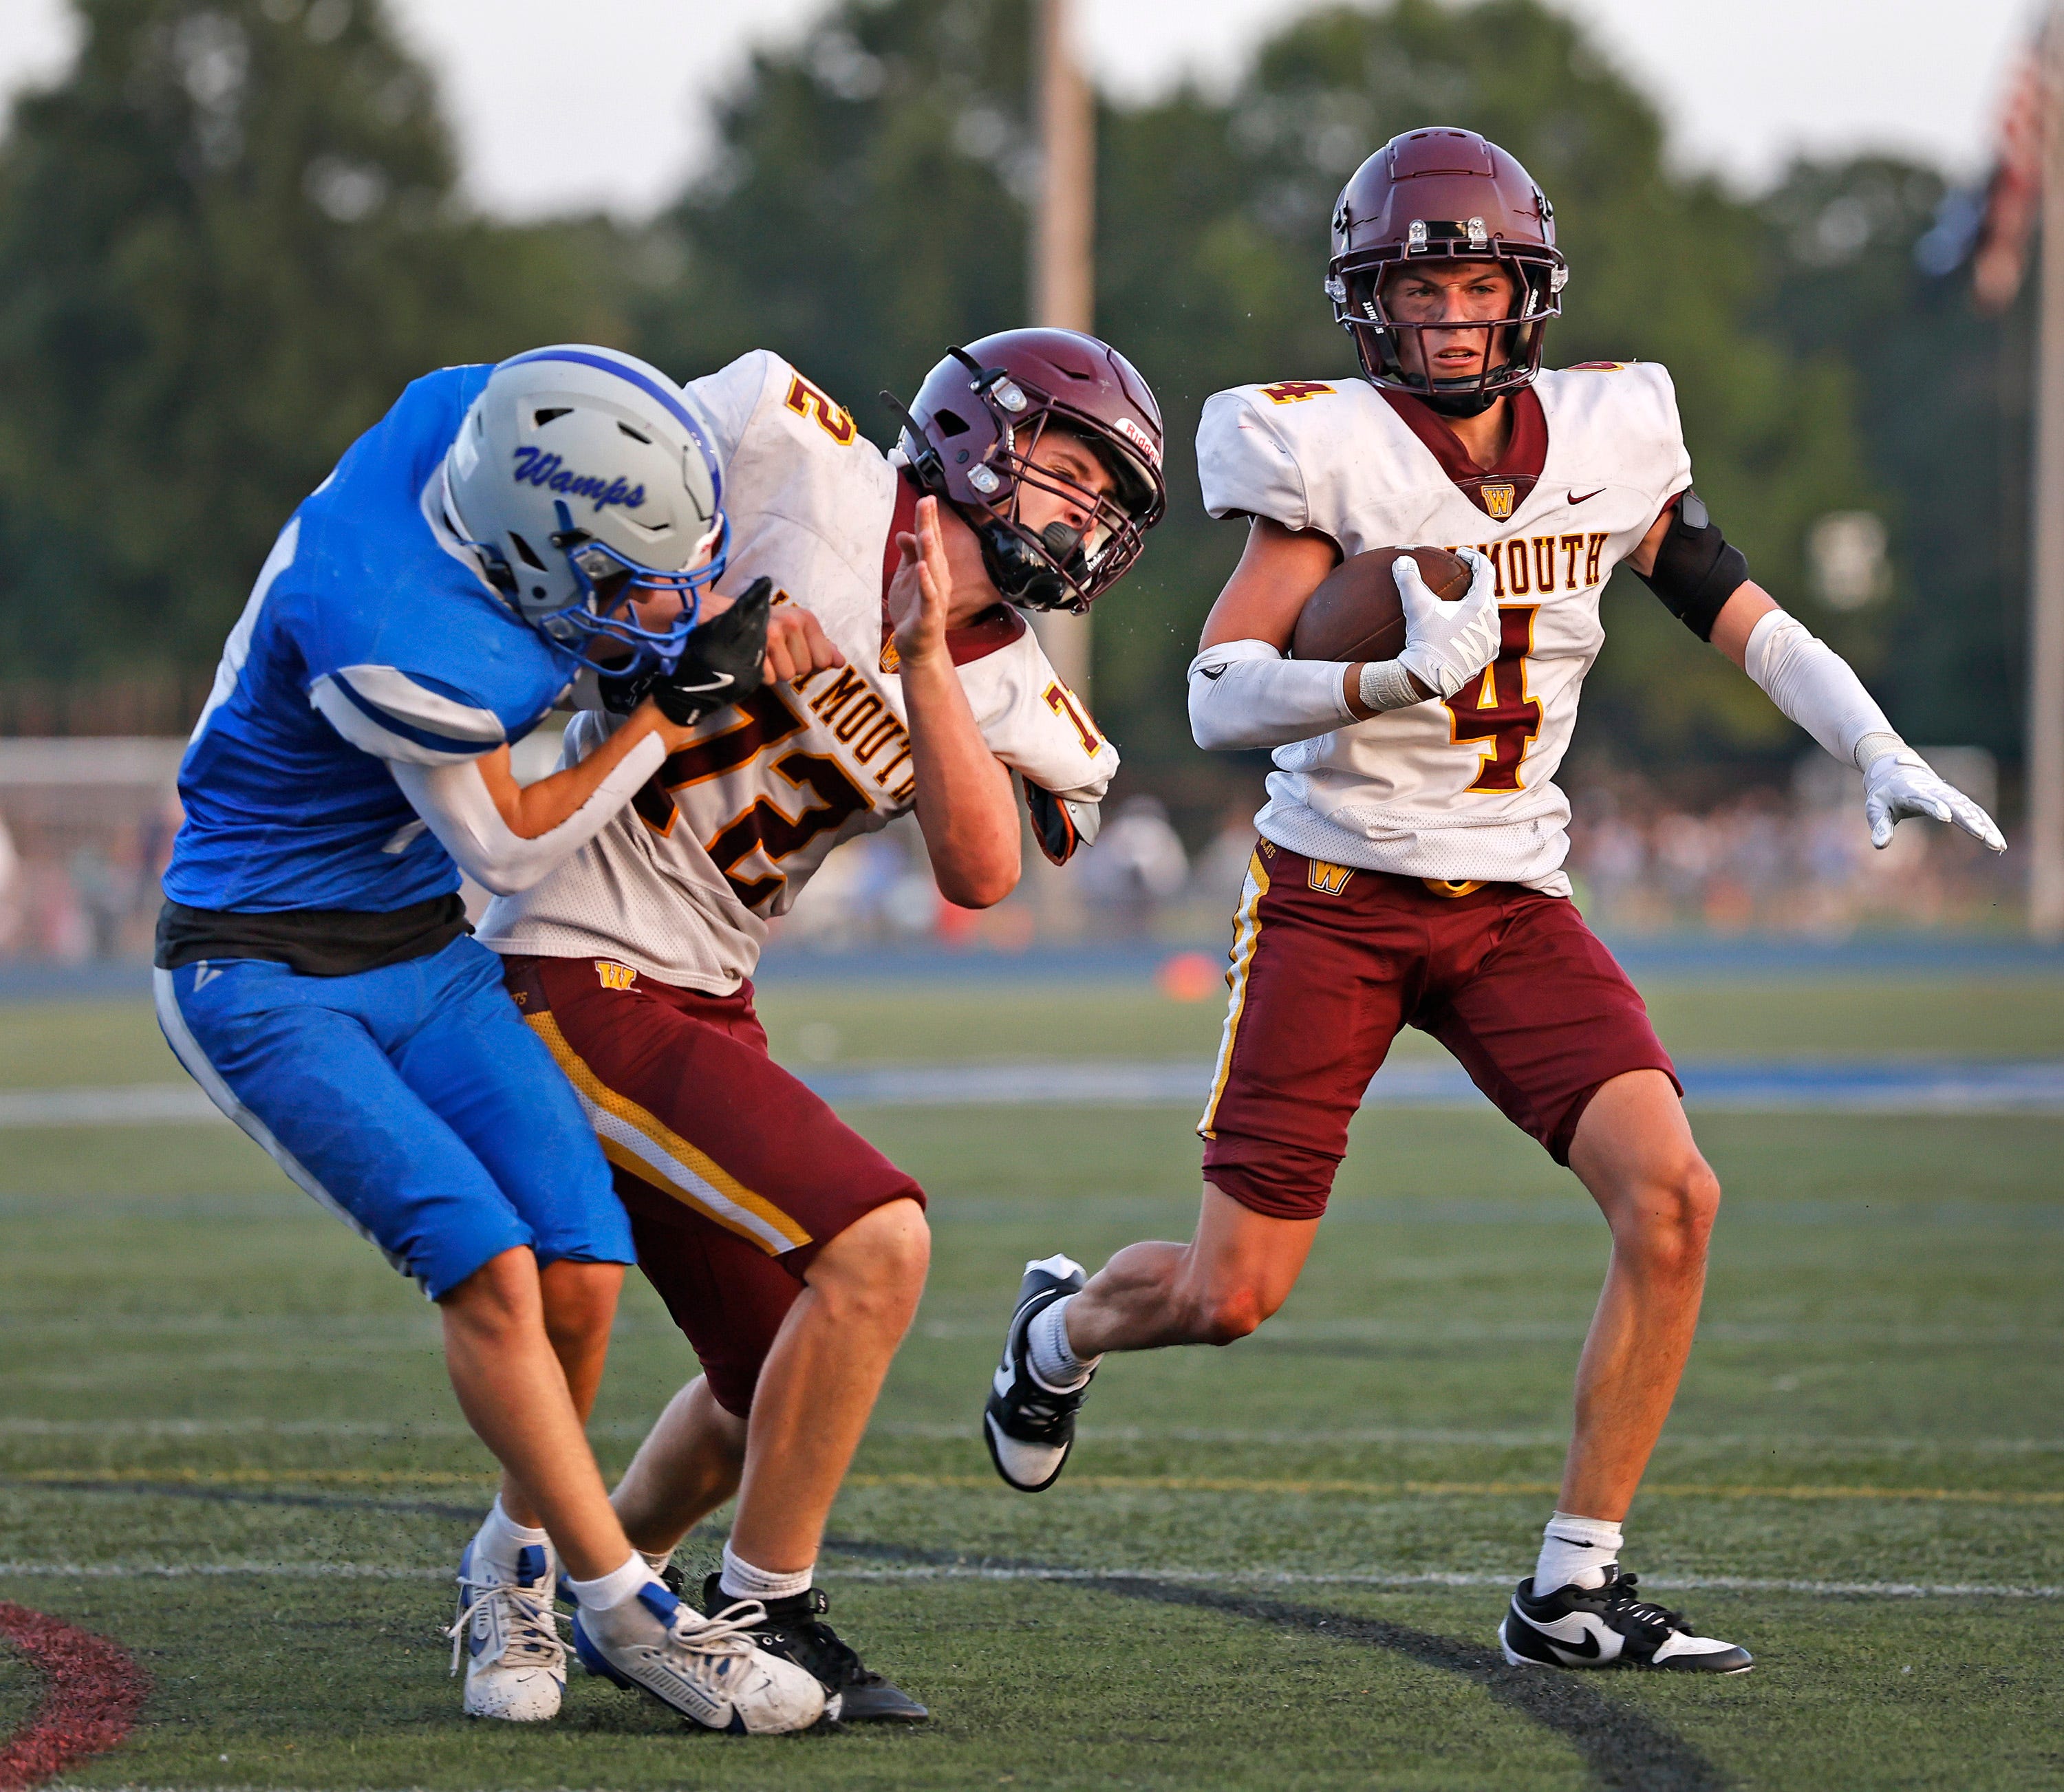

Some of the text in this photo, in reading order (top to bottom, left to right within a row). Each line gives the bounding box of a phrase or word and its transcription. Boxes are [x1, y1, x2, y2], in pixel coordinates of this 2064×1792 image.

[785, 374, 857, 446] 2
[1254, 381, 1337, 404] 4
[514, 446, 645, 512] Wamps
[1481, 484, 1515, 517] W
[1444, 532, 1609, 598] MOUTH
[1040, 673, 1106, 759] 7
[1440, 603, 1542, 793] 4
[631, 683, 877, 909] 72
[1309, 859, 1357, 896] W
[594, 961, 641, 991] W
